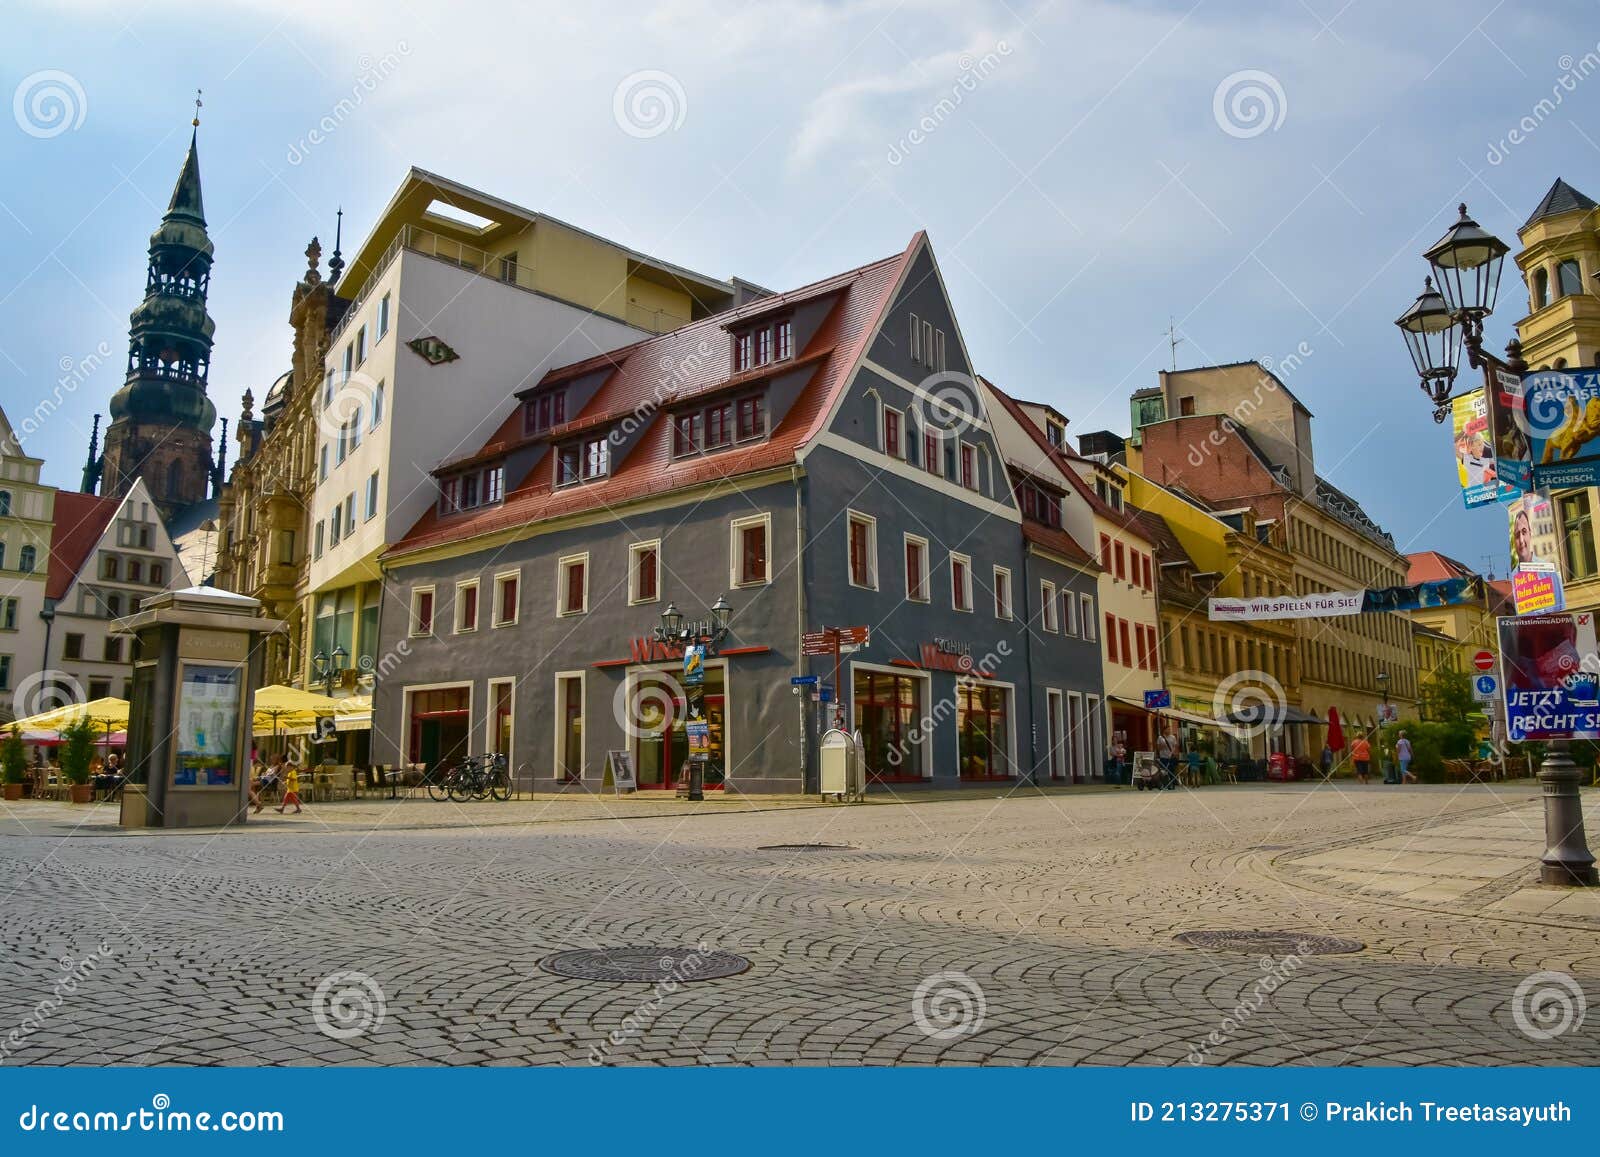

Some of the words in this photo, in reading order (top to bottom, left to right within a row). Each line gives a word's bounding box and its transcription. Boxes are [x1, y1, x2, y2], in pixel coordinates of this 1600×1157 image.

[1533, 374, 1576, 390] MUT
[1583, 373, 1600, 389] Z
[1251, 604, 1270, 613] WIR
[1272, 602, 1312, 611] SPIELEN
[1315, 599, 1334, 609] FÜR
[1338, 598, 1357, 608] SIE!
[1566, 674, 1597, 685] ADPM
[1509, 690, 1564, 707] JETZT
